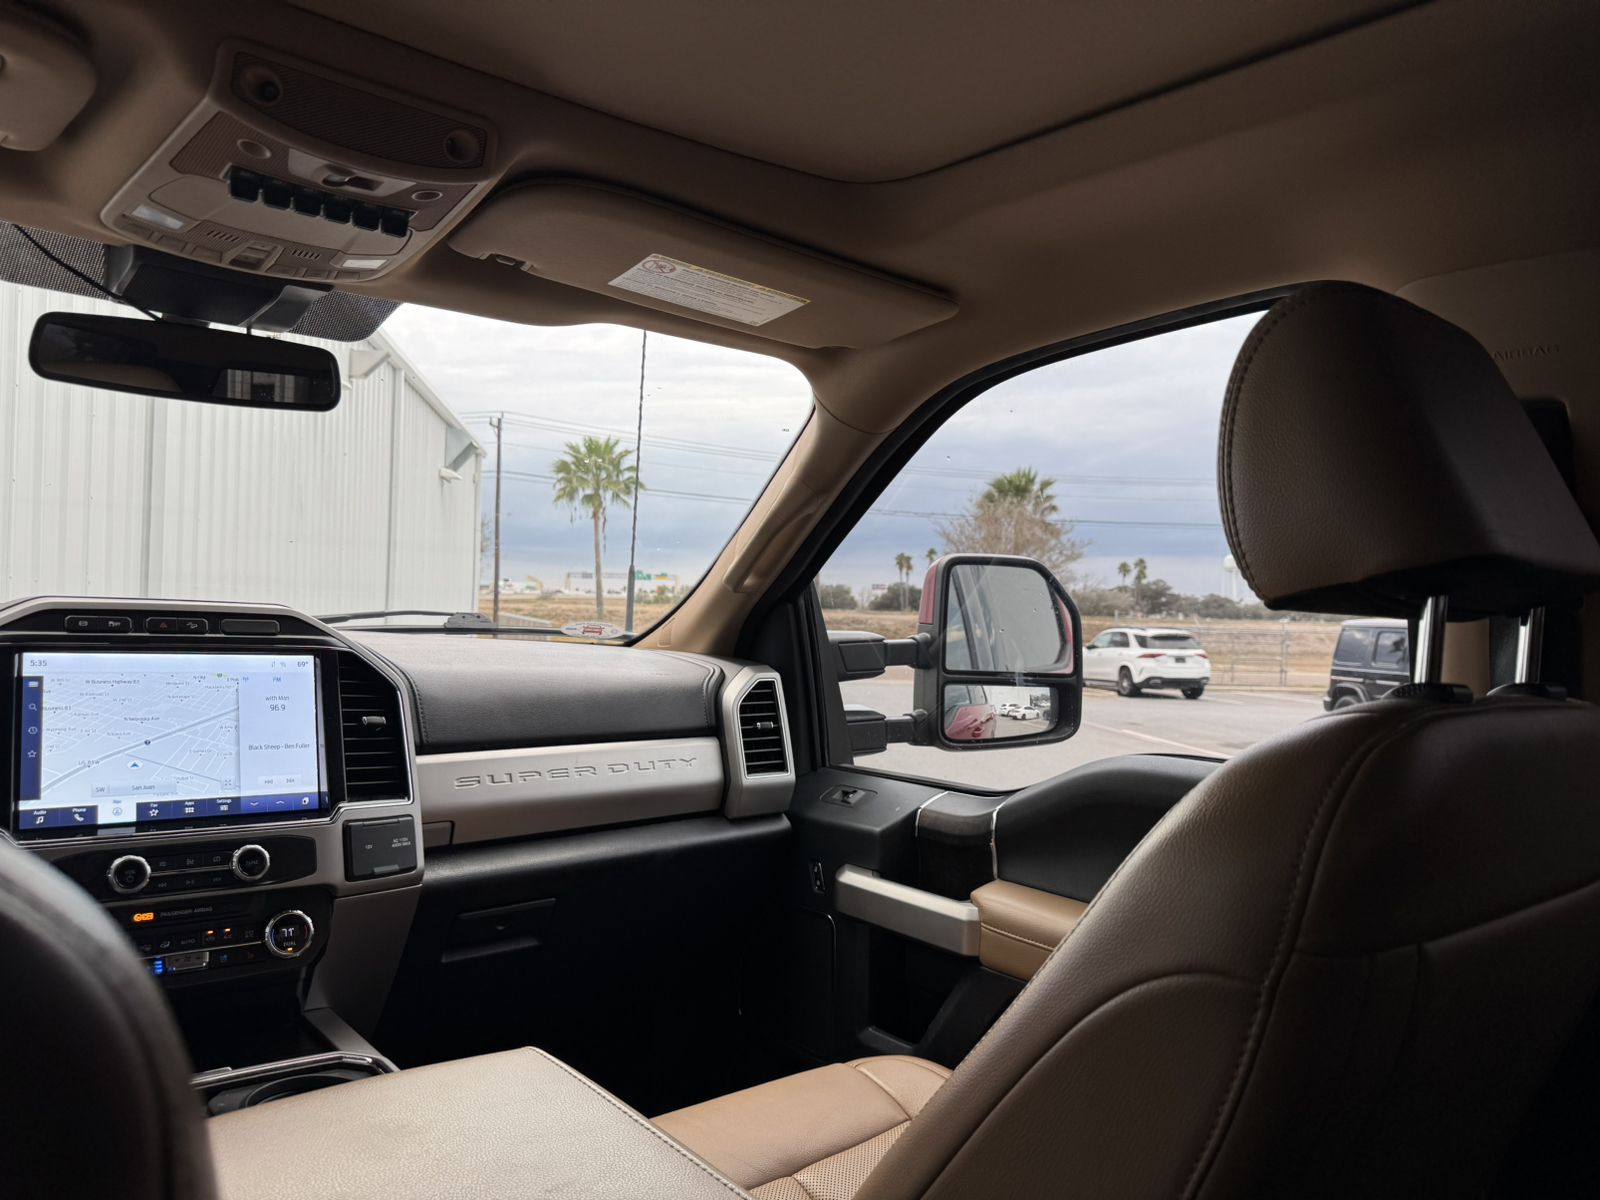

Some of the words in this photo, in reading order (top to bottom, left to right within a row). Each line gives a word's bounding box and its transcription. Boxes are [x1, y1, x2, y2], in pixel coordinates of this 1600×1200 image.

[454, 766, 597, 788] SUPER
[607, 758, 696, 775] DUTY
[160, 908, 192, 917] PASSENGER
